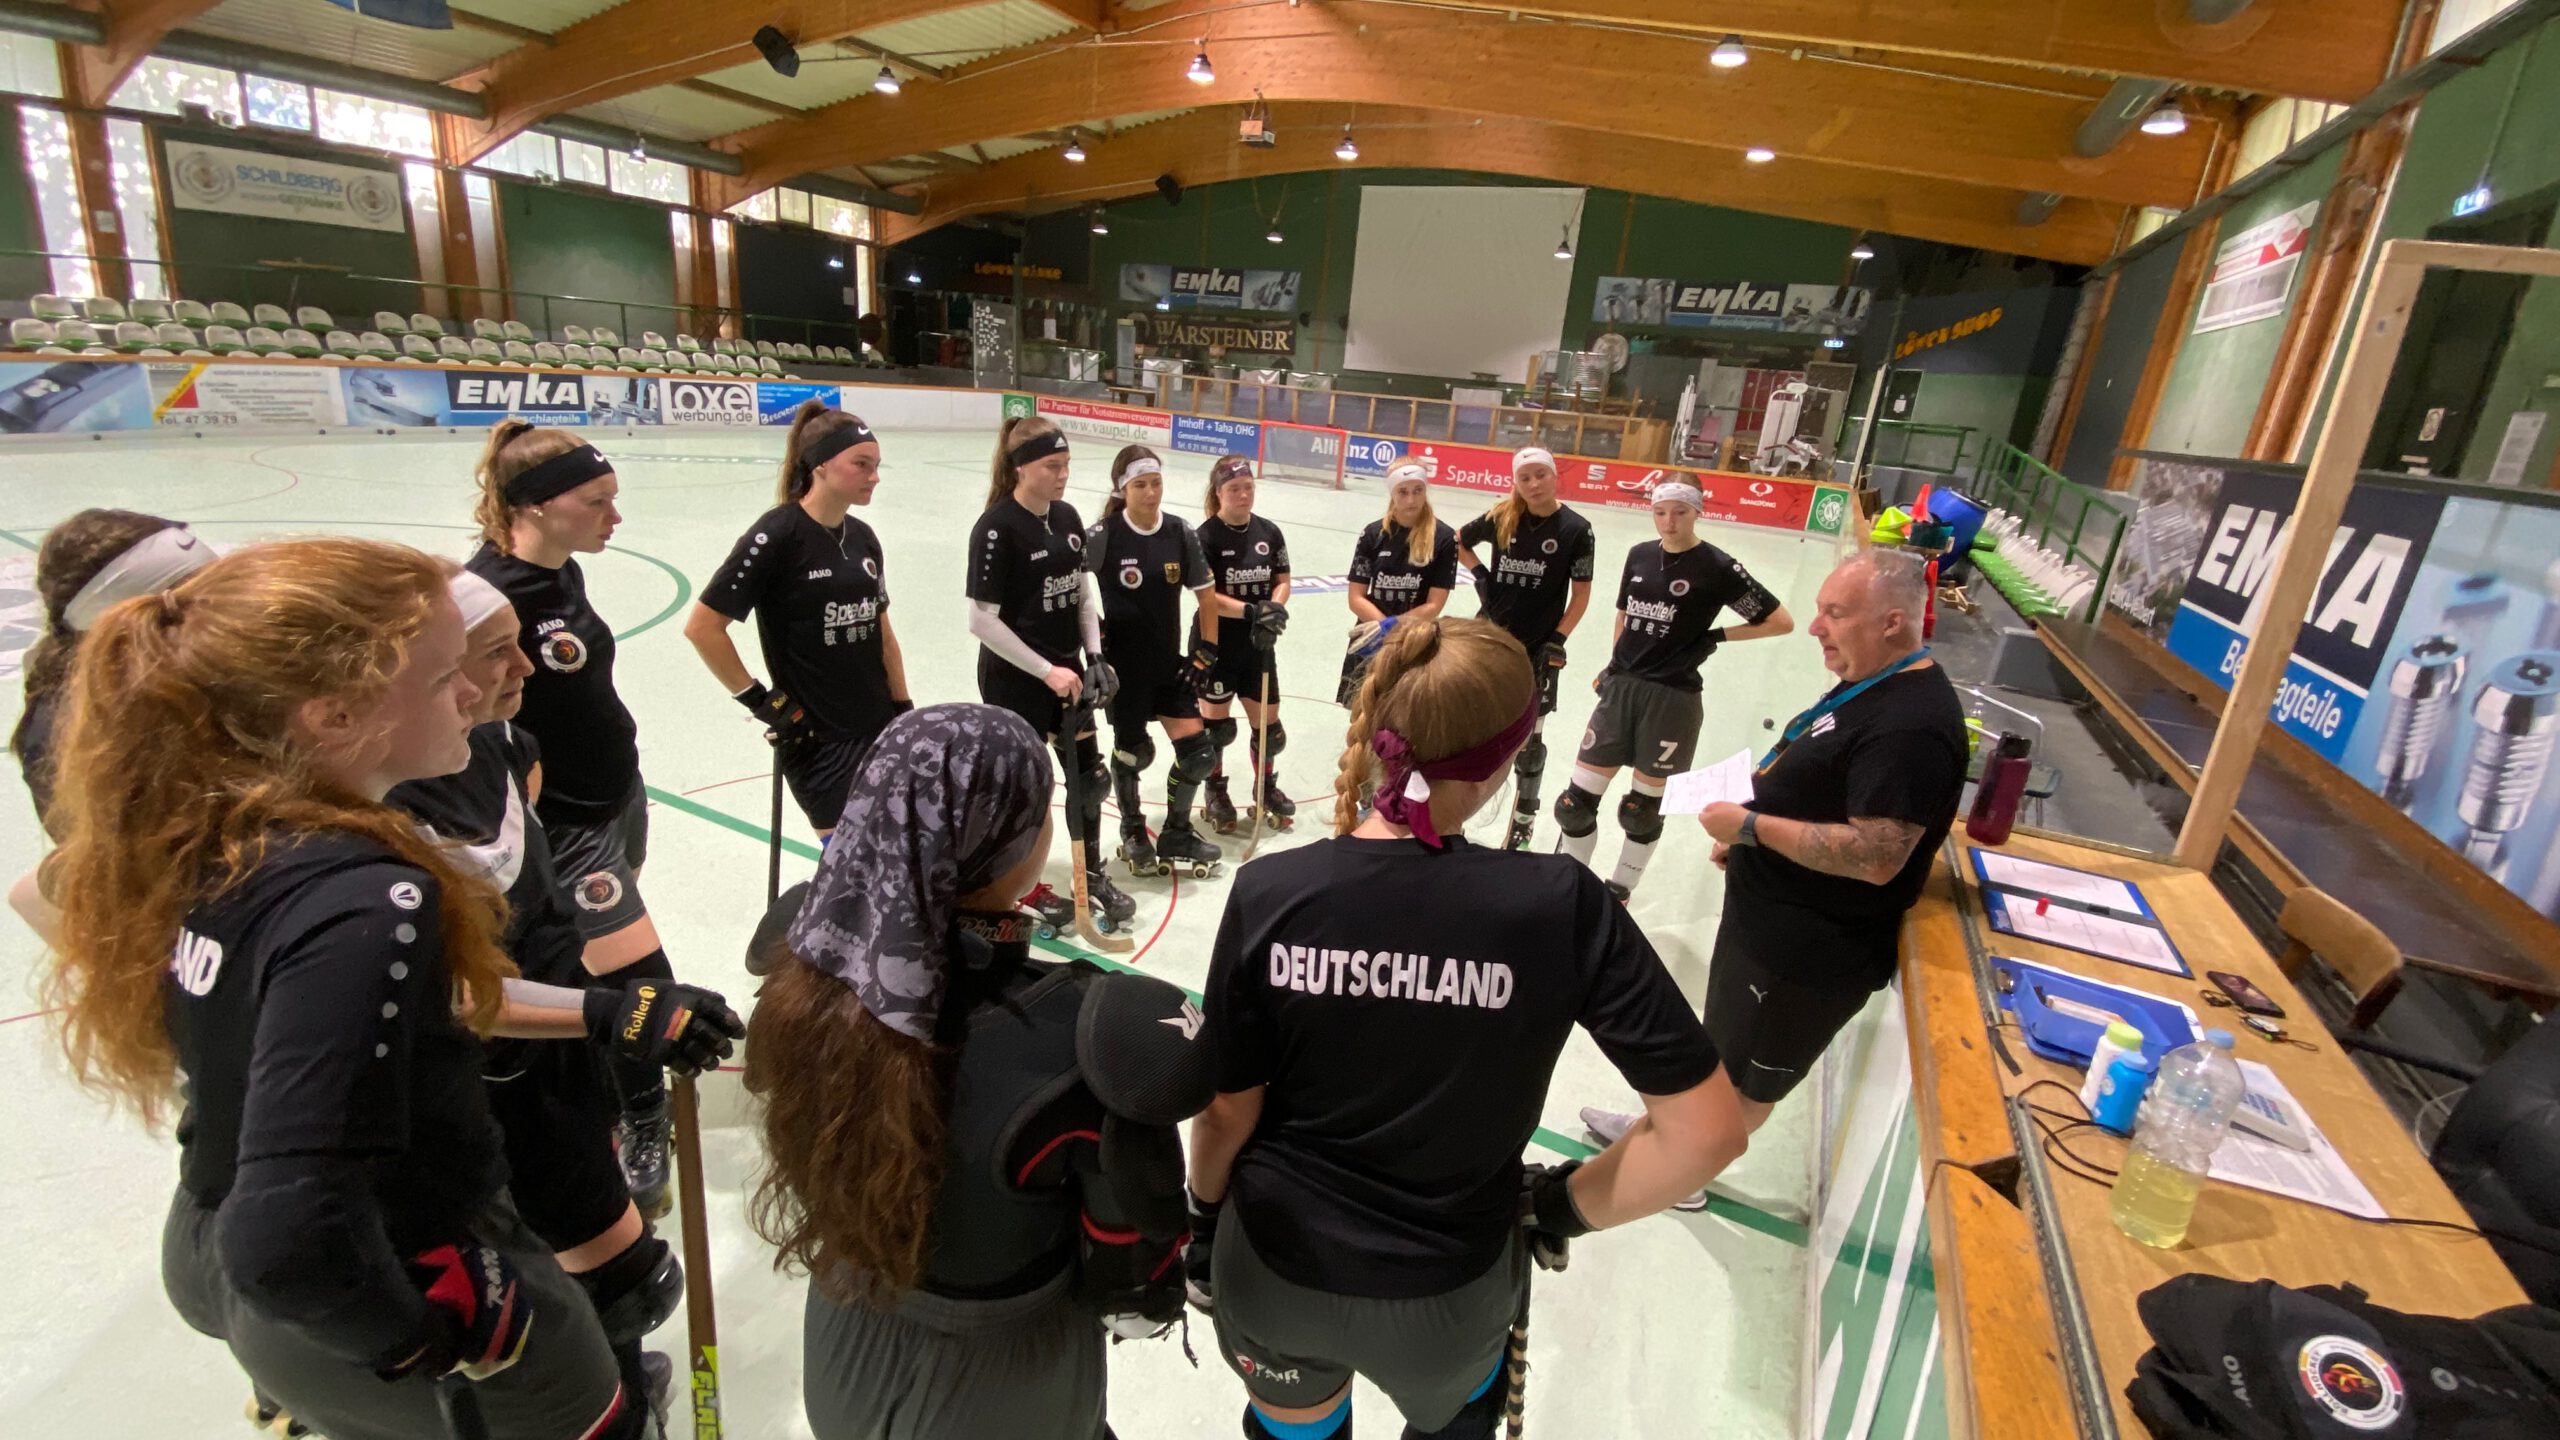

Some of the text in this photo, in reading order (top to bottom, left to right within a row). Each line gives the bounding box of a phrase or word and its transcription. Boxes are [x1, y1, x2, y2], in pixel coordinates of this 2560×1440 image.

[236, 164, 343, 193] SCHILDBERG
[1154, 320, 1290, 350] WARSTEINER
[457, 373, 579, 412] EMKA
[674, 384, 752, 411] oxe
[672, 409, 753, 425] werbung.de
[1052, 401, 1078, 413] Partner
[1092, 405, 1170, 428] Notstromversorgung
[1060, 418, 1148, 441] www.vaupel.de
[1178, 417, 1205, 431] Imhoff
[1214, 422, 1233, 434] Taha
[1235, 424, 1255, 436] OHG
[1578, 482, 1611, 492] SEAT
[808, 569, 832, 579] JAKO
[1226, 566, 1271, 582] Speedtek
[1499, 555, 1547, 575] Speedtek
[1376, 571, 1423, 588] Speedtek
[1627, 595, 1677, 622] Speedtek
[536, 618, 566, 636] JAKO
[1658, 740, 1678, 761] 7
[1270, 942, 1514, 1009] DEUTSCHLAND
